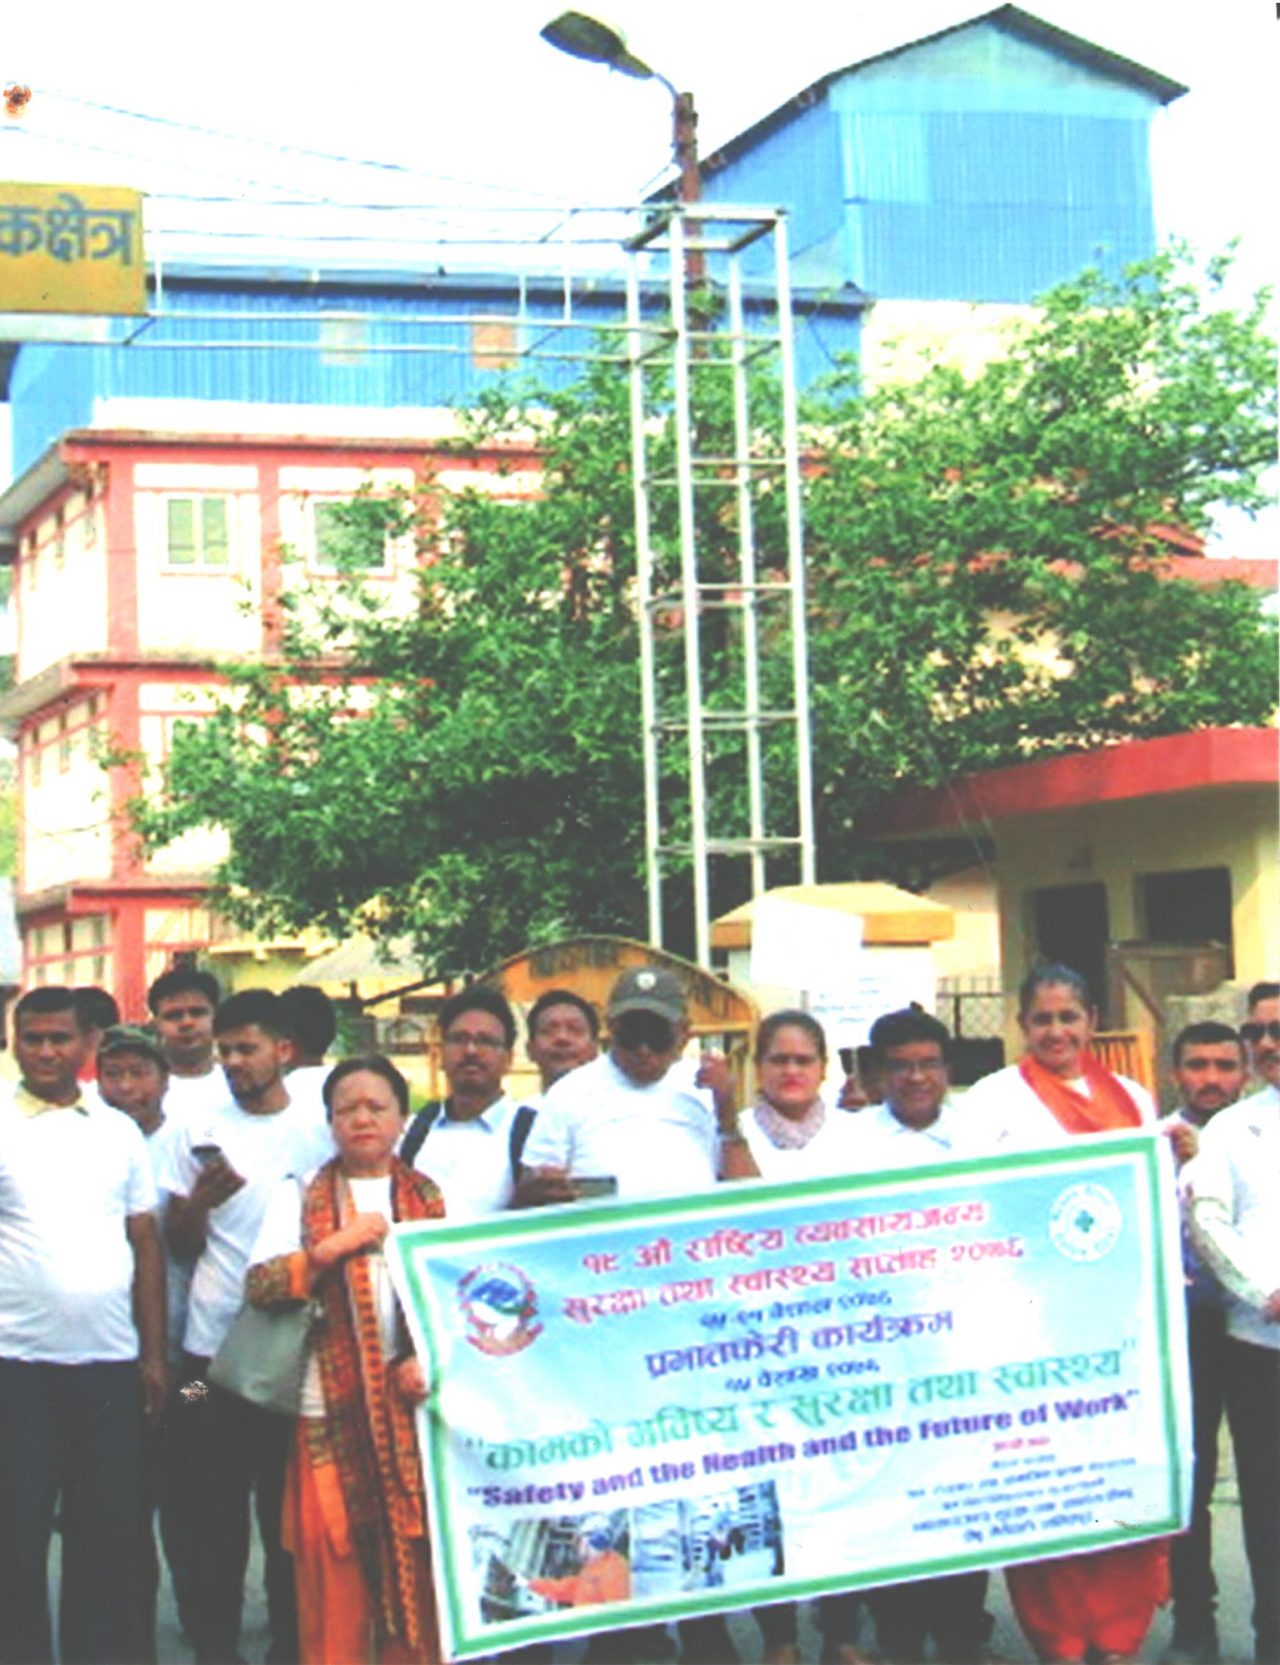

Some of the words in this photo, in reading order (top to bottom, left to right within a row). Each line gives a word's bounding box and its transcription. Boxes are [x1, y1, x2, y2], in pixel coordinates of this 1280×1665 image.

[591, 1468, 645, 1497] and
[648, 1460, 696, 1485] the
[802, 1431, 858, 1459] and
[863, 1424, 912, 1449] the
[919, 1411, 1013, 1441] Future
[1019, 1403, 1049, 1427] of
